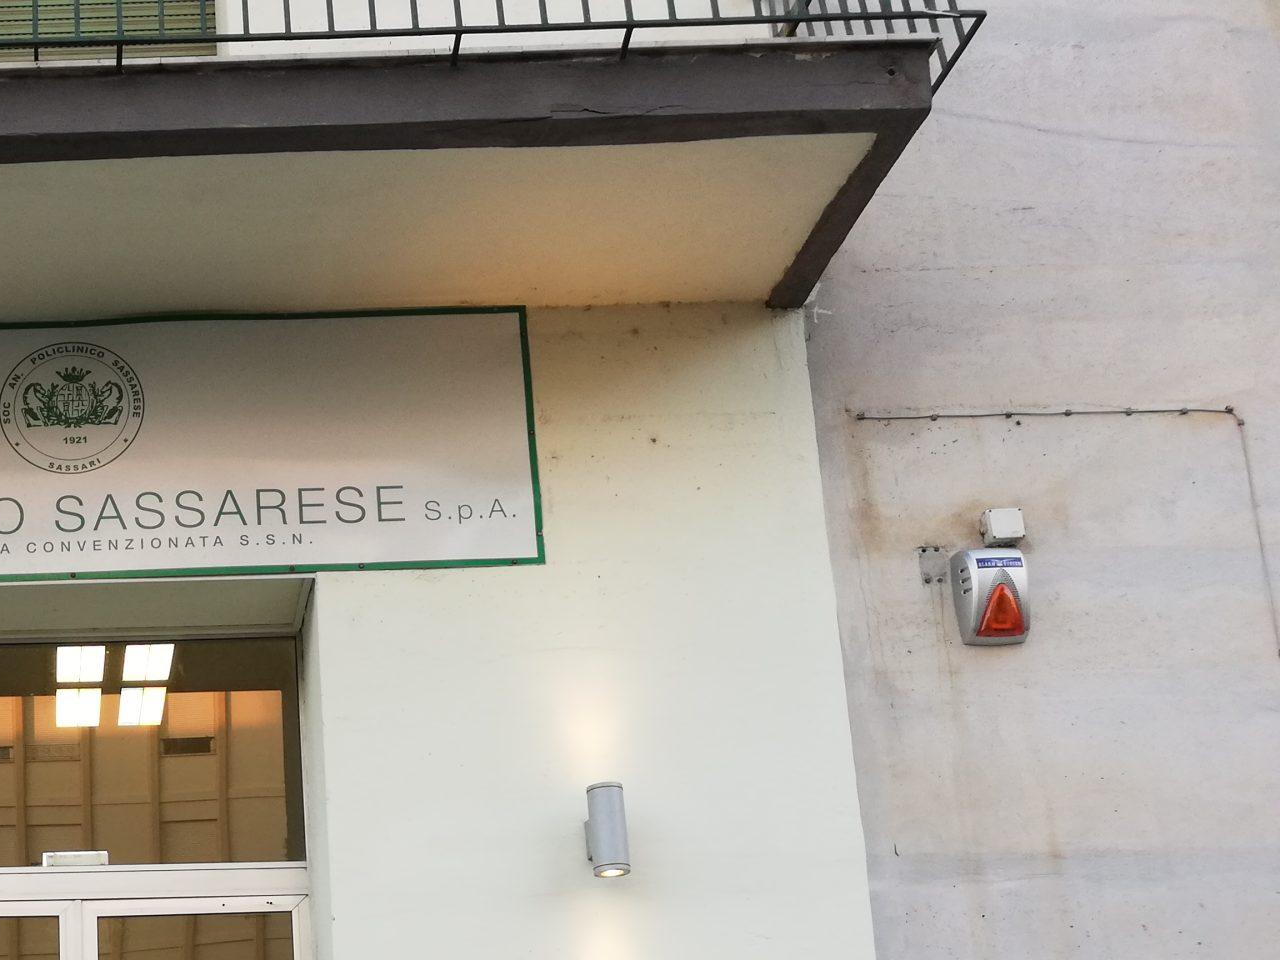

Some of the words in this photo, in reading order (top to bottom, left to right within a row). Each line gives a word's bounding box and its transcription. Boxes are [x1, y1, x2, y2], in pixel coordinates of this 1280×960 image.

[30, 345, 105, 365] POLICLINICO
[111, 358, 141, 418] SASSARESE
[62, 436, 88, 444] 1921
[48, 457, 101, 472] SASSARI
[54, 485, 405, 533] SASSARESE
[424, 498, 517, 524] S.p.A.
[26, 535, 223, 554] CONVENZIONATA
[239, 533, 314, 548] S.S.N.
